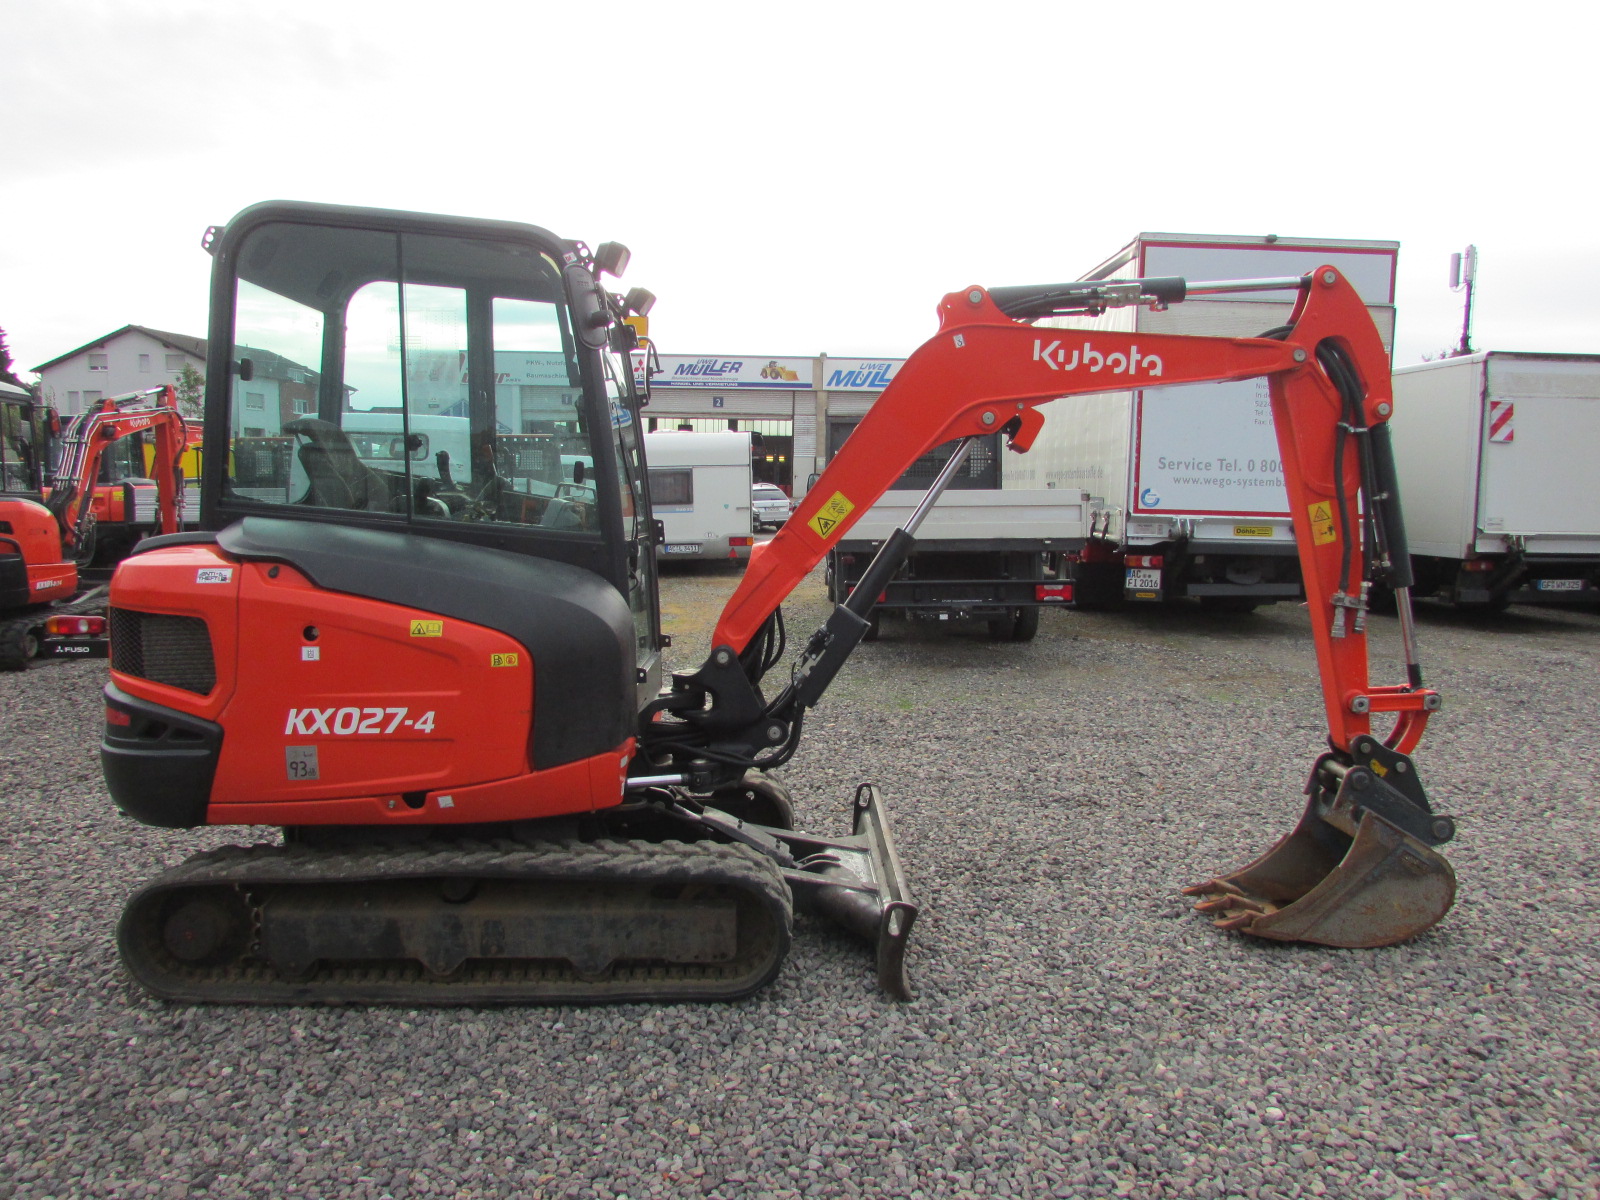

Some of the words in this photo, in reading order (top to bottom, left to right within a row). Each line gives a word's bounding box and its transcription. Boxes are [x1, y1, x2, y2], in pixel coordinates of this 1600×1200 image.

[1033, 339, 1163, 376] Kubota
[674, 359, 743, 376] MÜLLER
[859, 362, 886, 371] UWE
[715, 398, 722, 408] 2
[1158, 456, 1212, 471] Service
[1217, 458, 1242, 472] Tel.
[1247, 459, 1256, 472] 0
[1131, 569, 1142, 578] AC
[1139, 579, 1159, 588] 2016
[285, 707, 436, 736] KX027-4
[290, 760, 308, 778] 93
